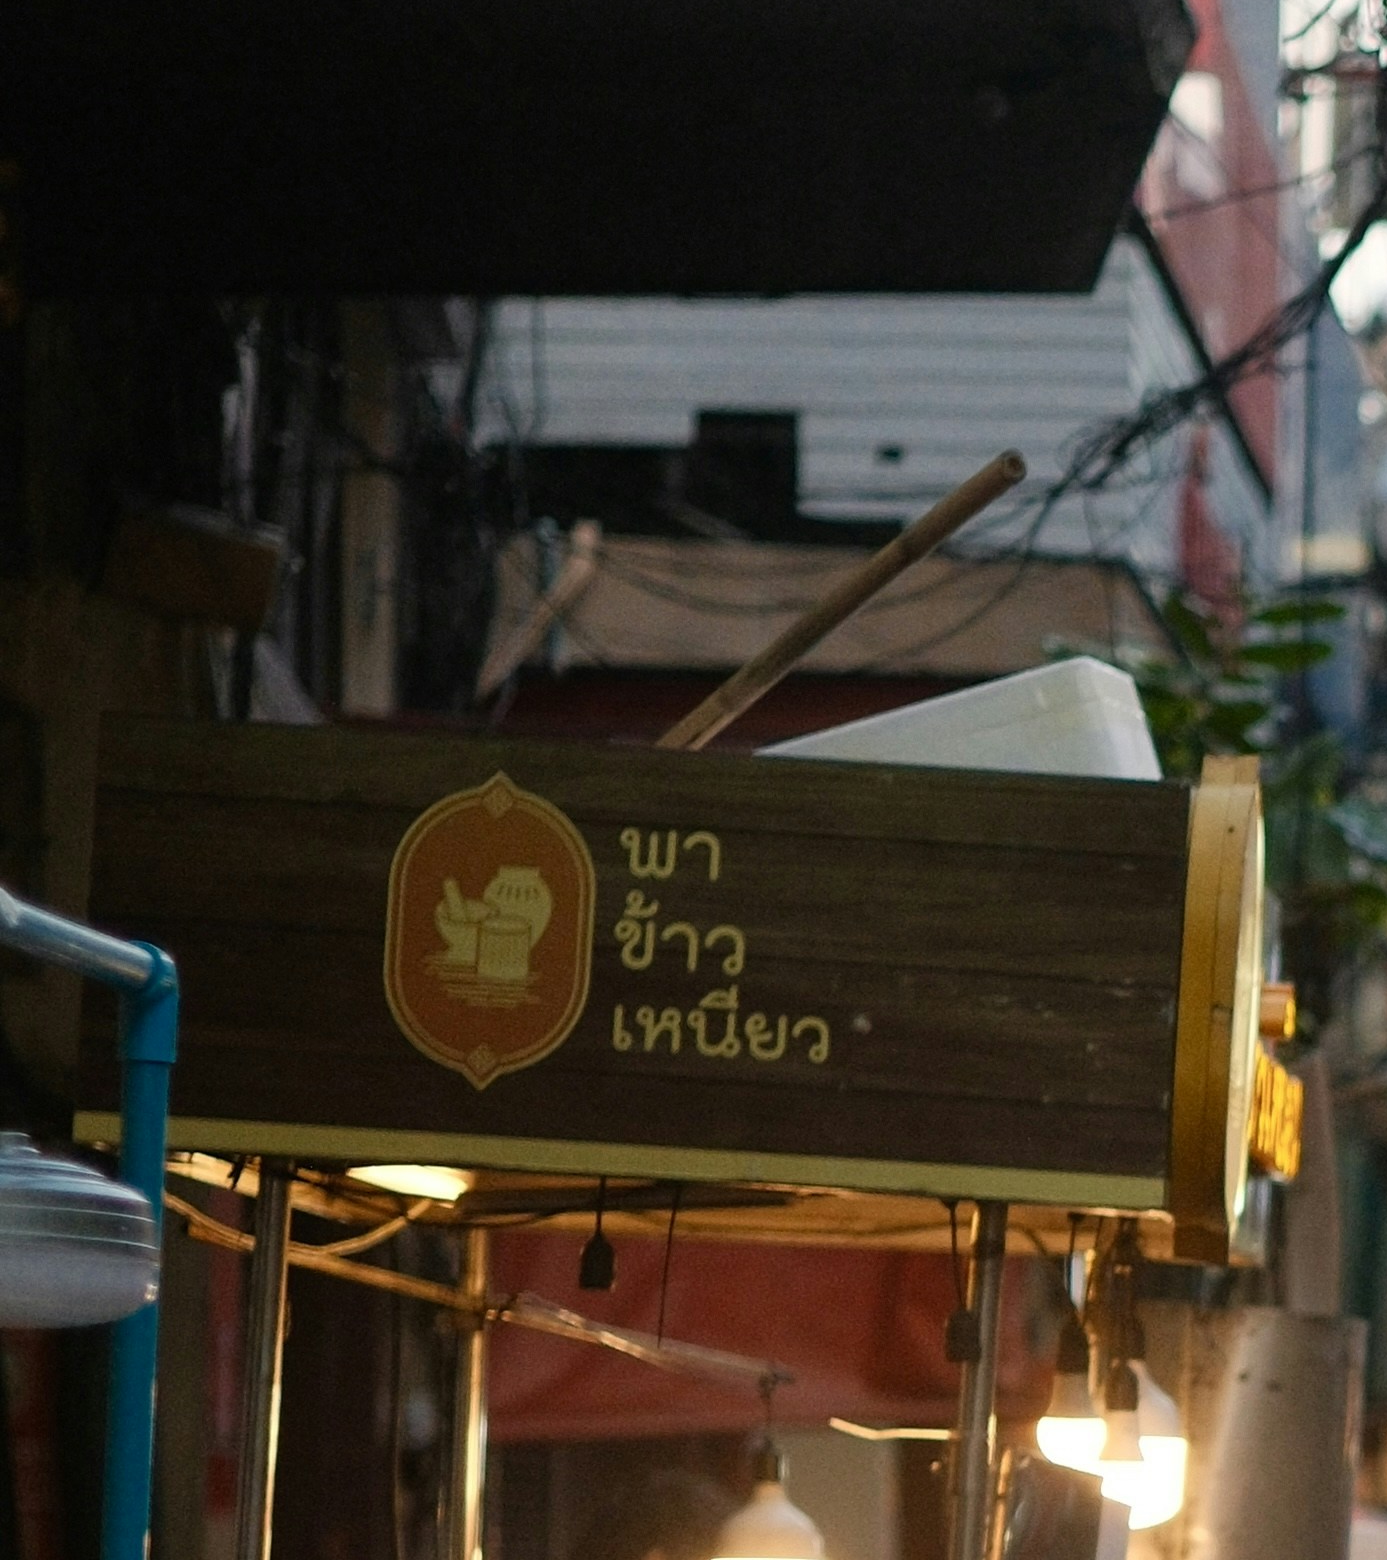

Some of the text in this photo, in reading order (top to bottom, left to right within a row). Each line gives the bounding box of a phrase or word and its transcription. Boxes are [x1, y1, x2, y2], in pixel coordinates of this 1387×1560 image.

[620, 827, 721, 882] พา
[614, 890, 745, 977] ข้าว
[613, 984, 830, 1063] เหนียว
